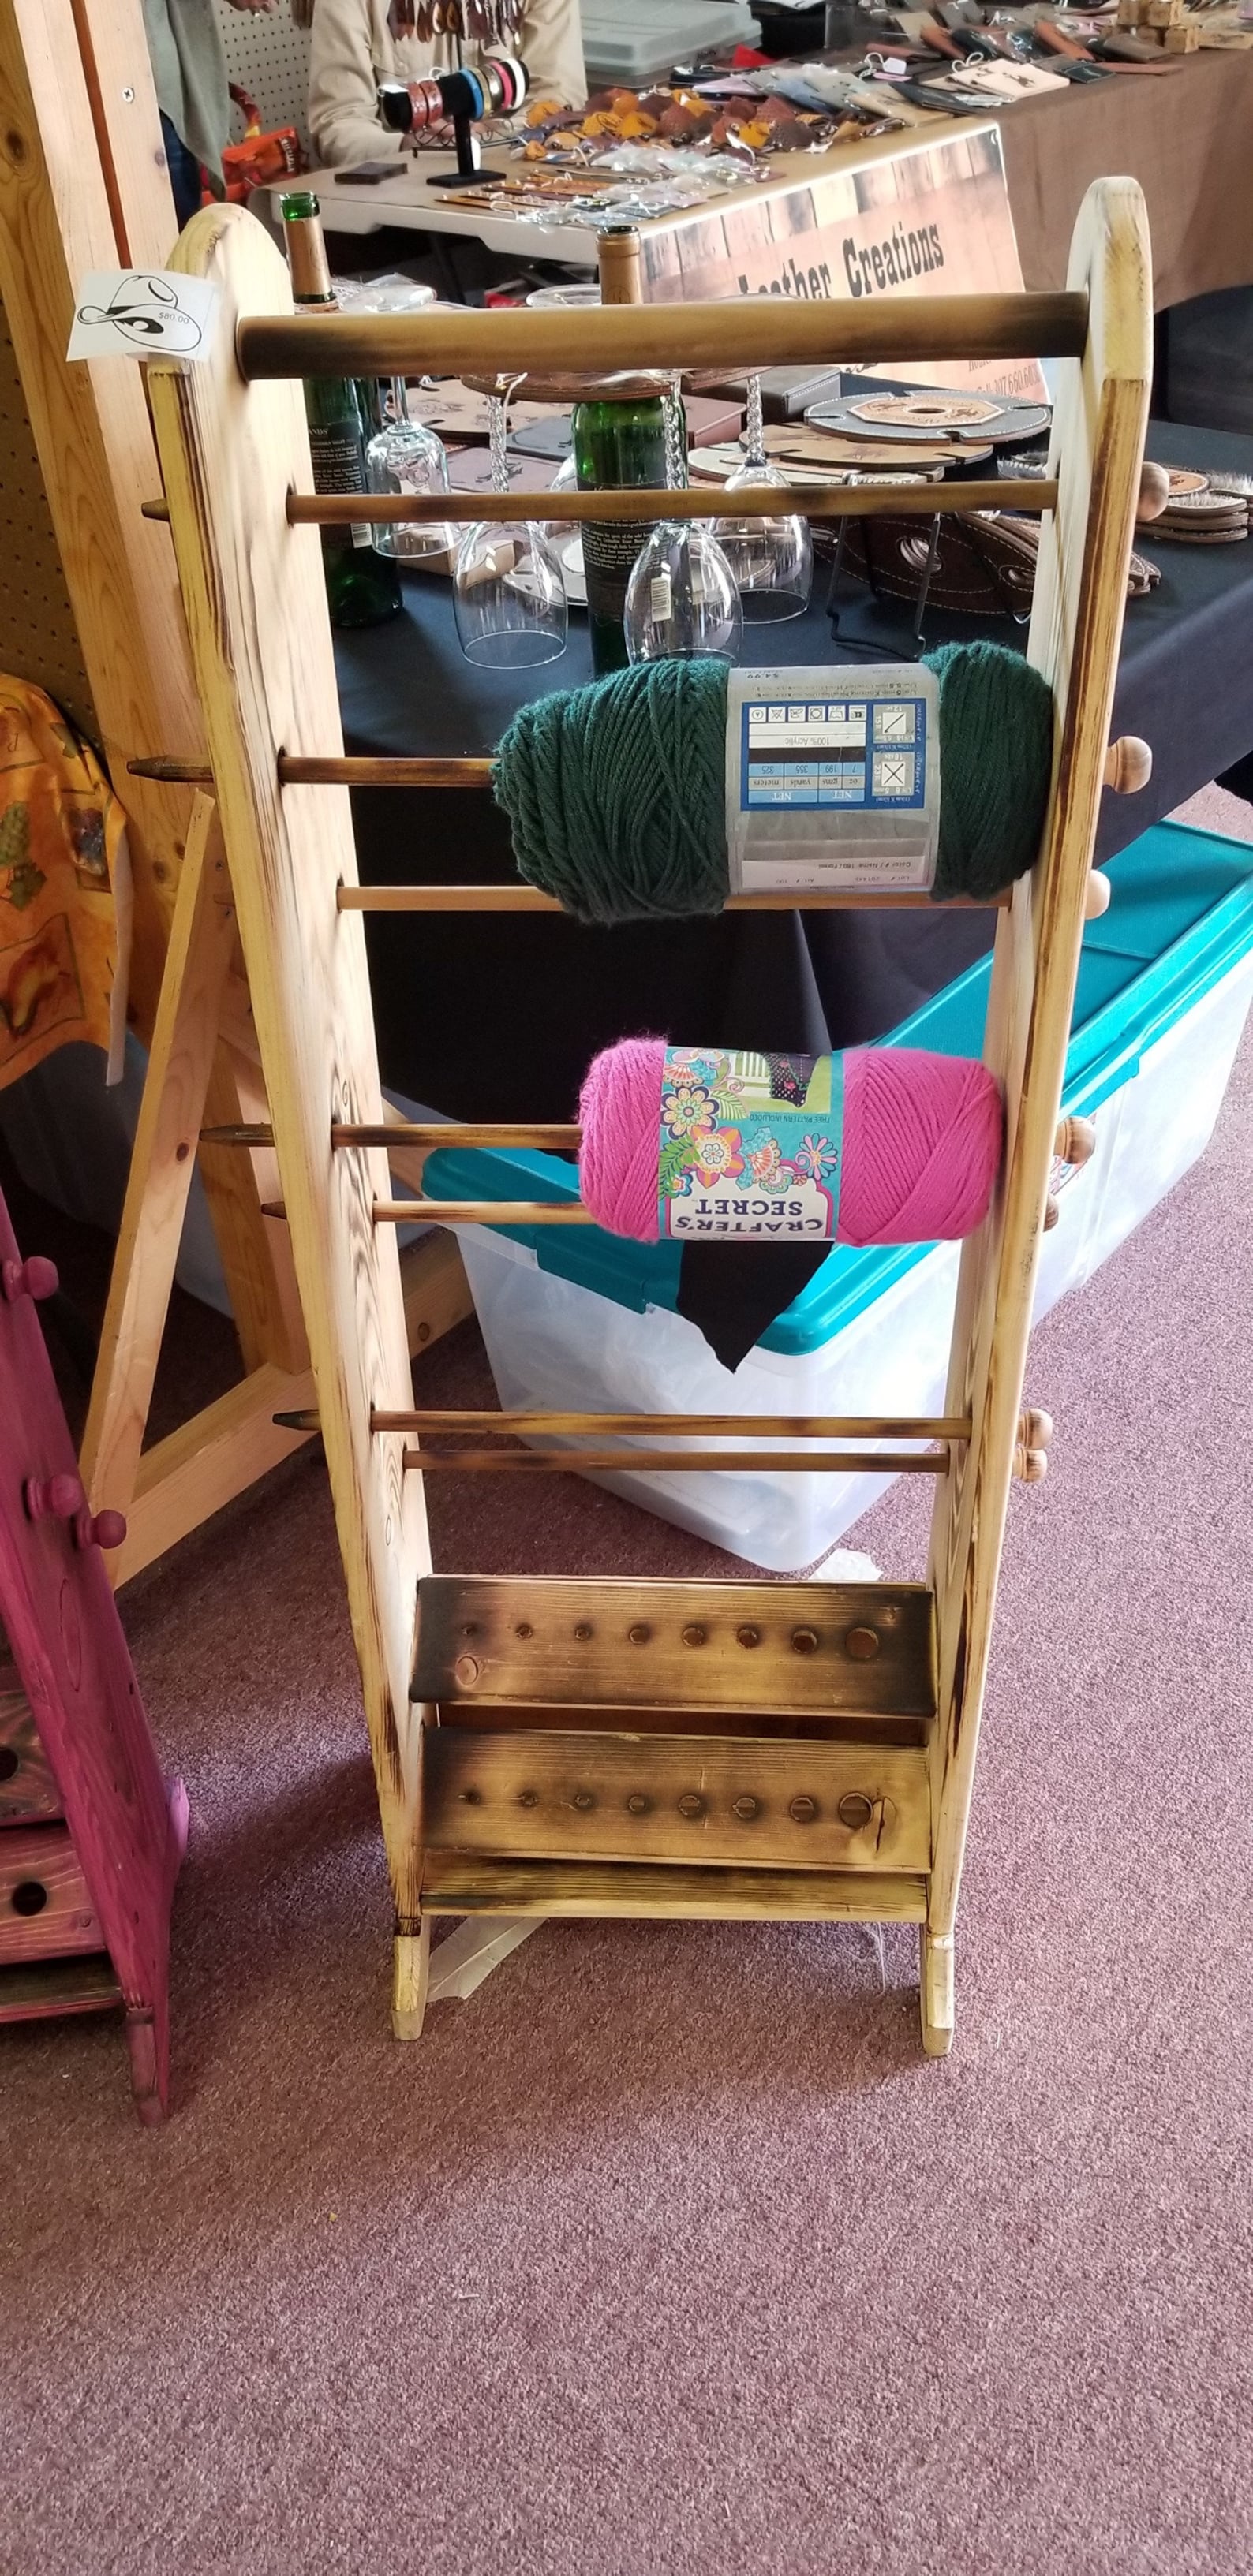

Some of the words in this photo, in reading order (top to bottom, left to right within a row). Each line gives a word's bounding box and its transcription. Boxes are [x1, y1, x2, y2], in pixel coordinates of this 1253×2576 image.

[737, 257, 832, 299] ther
[842, 221, 944, 298] Creations
[158, 312, 189, 324] $80.00
[784, 736, 808, 745] Acrylic
[810, 737, 829, 745] 100%
[761, 765, 774, 774] 325
[795, 764, 808, 774] 355
[825, 764, 837, 773] 199
[851, 764, 857, 773] 7
[753, 779, 780, 789] meters
[790, 778, 810, 787] yards
[771, 791, 791, 801] NET
[832, 790, 852, 799] NET
[749, 1114, 782, 1122] INCLUDED
[783, 1114, 813, 1124] PATTERN
[694, 1198, 803, 1216] SECRET
[675, 1215, 823, 1233] CRAFTER'S
